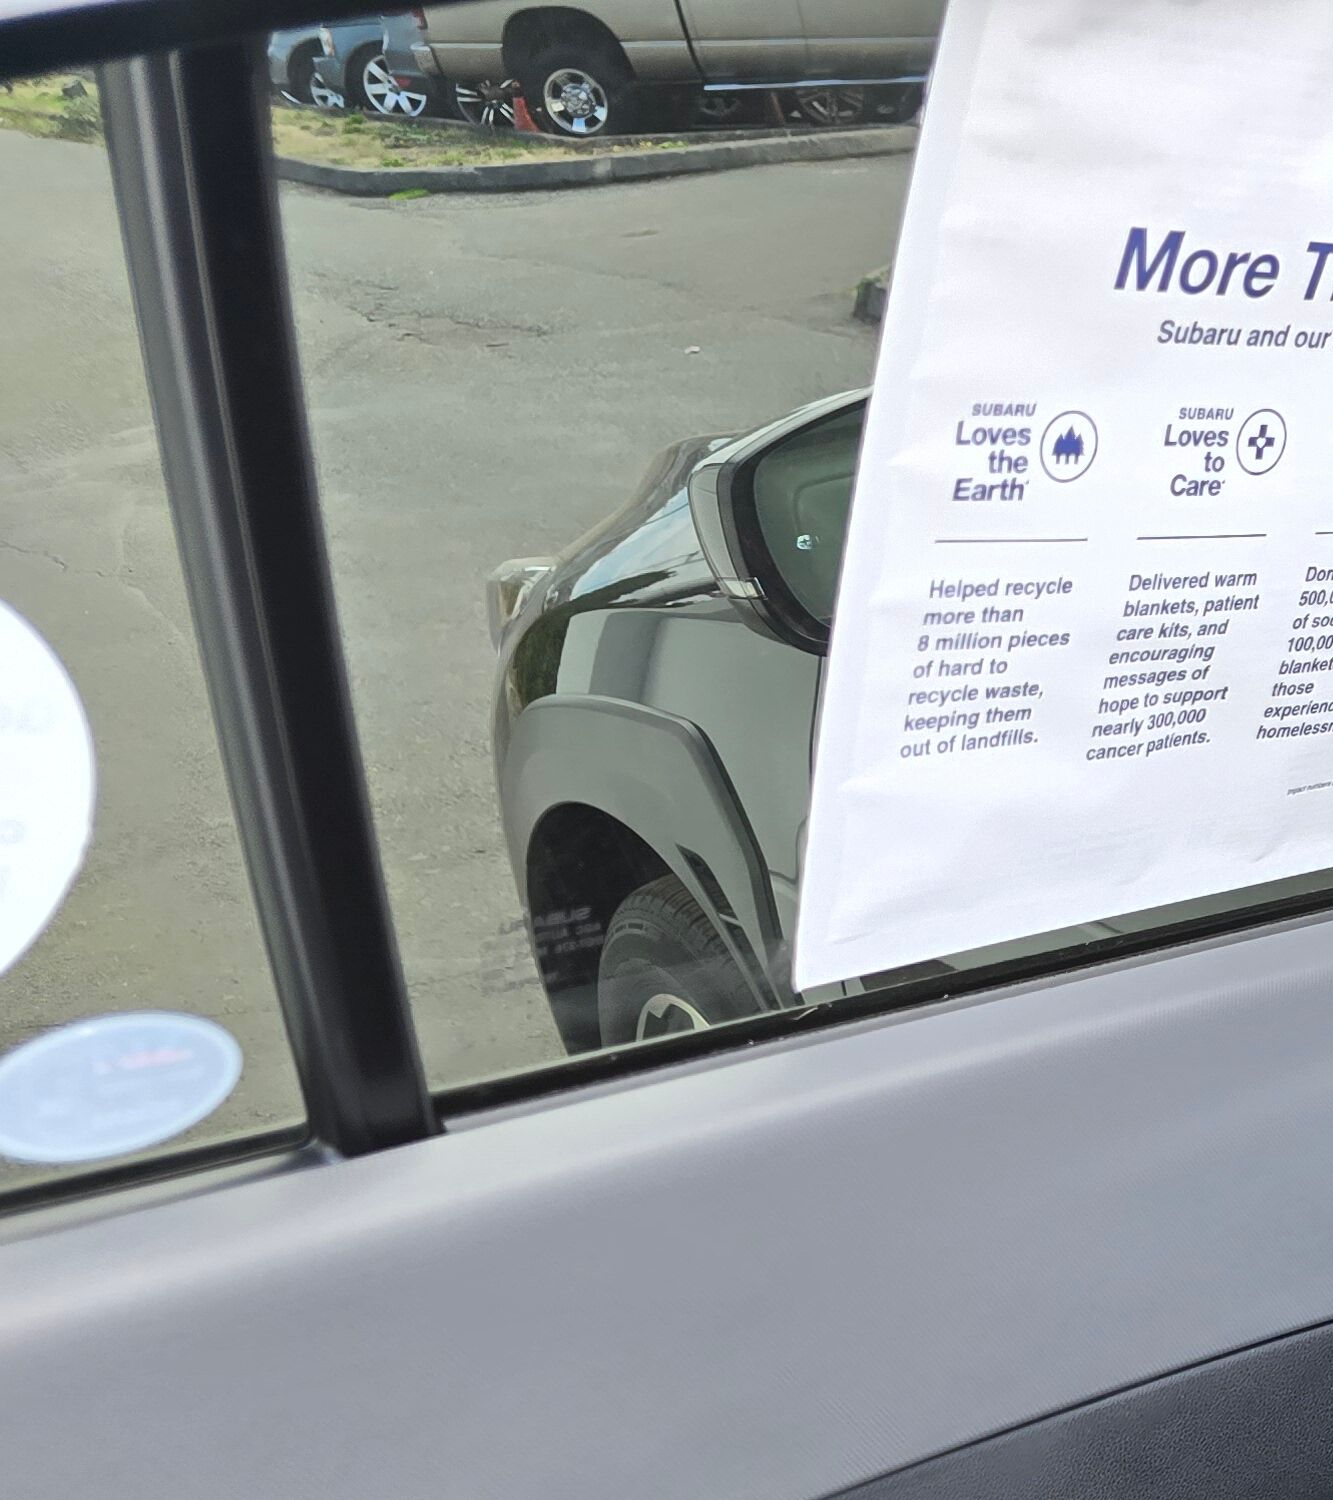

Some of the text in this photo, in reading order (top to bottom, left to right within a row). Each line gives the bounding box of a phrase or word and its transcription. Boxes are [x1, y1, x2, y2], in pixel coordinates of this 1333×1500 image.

[1115, 227, 1279, 298] More
[1158, 320, 1241, 345] Subaru
[1247, 325, 1290, 346] and
[1295, 332, 1332, 348] our
[972, 404, 1036, 416] SUBARU
[1179, 408, 1234, 420] SUBARU
[956, 421, 1031, 446] Loves
[1164, 424, 1229, 447] Loves
[989, 450, 1028, 473] the
[1205, 452, 1224, 472] to
[953, 478, 1024, 501] Earth
[1171, 474, 1221, 496] Care
[930, 577, 1072, 601] Helped recycle
[1129, 572, 1257, 591] Delivered warm
[923, 607, 1023, 625] more than
[1123, 595, 1259, 617] blankets, patient
[1117, 619, 1229, 641] care kits, and
[1293, 614, 1309, 629] of
[918, 631, 1070, 652] 8 million pieces
[1109, 644, 1215, 664] encouraging
[913, 658, 1007, 678] of hard to
[1104, 665, 1210, 689] messages of
[909, 682, 1042, 707] recycle waste,
[1099, 687, 1228, 715] hope to support
[1272, 683, 1314, 696] those
[904, 708, 1031, 732] keeping them
[1092, 709, 1206, 737] nearly 300,000
[901, 729, 1037, 758] out of landfills.
[1086, 731, 1210, 760] cancer patients.
